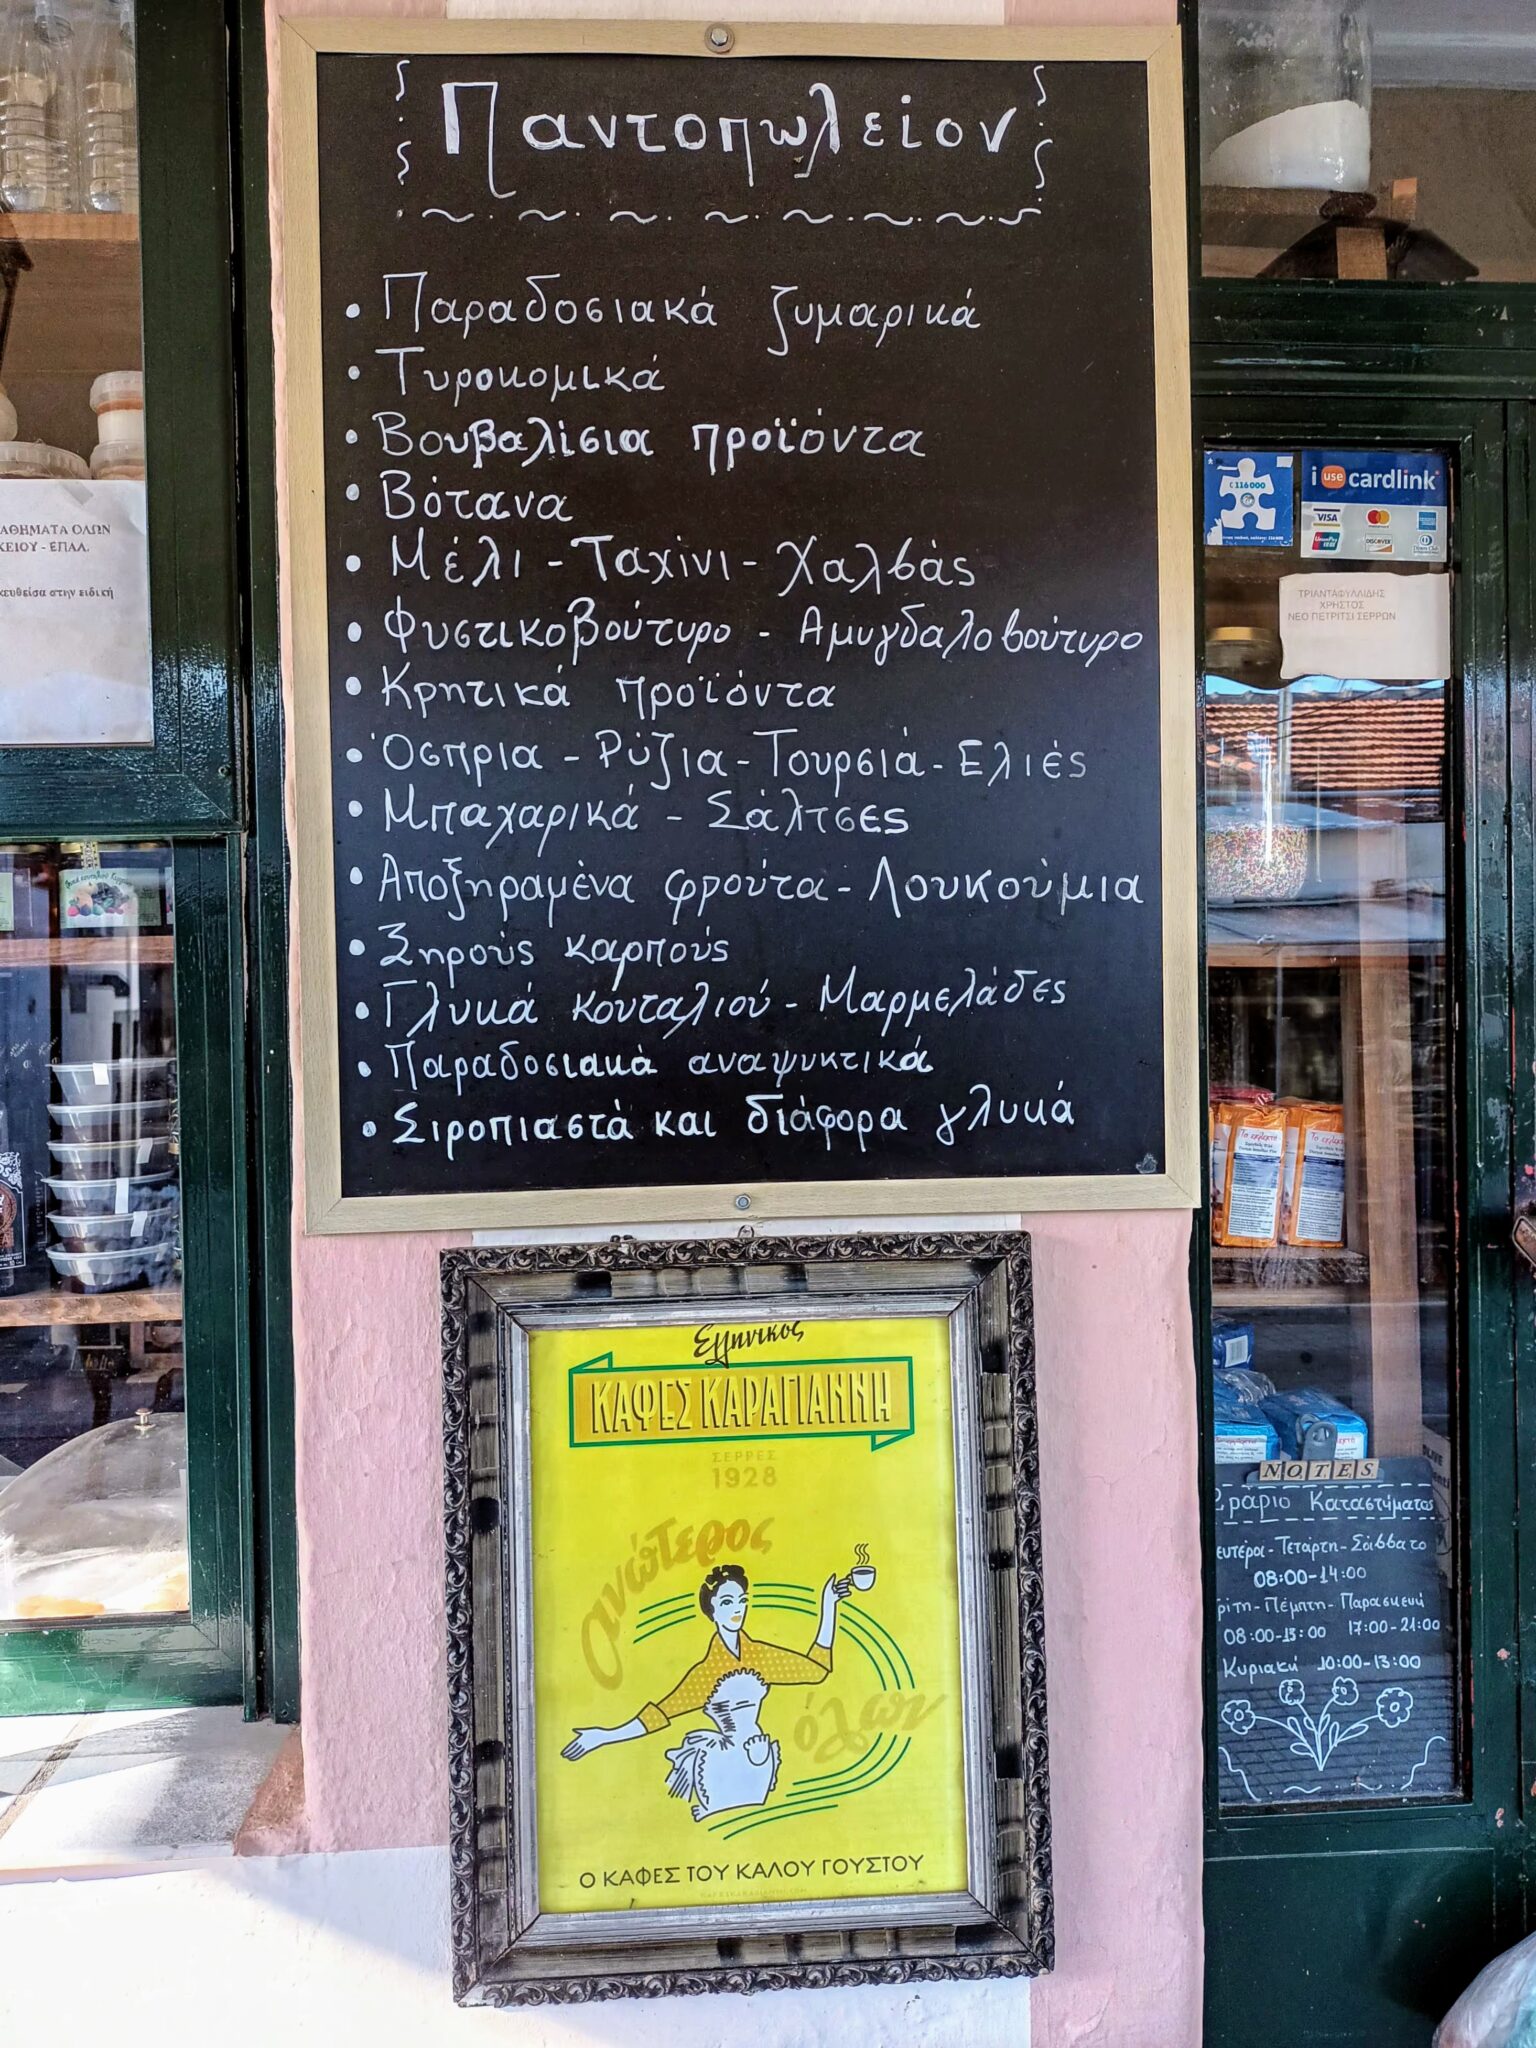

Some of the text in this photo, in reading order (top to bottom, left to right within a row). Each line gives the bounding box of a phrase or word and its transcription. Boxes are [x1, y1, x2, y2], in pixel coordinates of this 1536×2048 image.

[441, 82, 1017, 199] Παντοπωλείον
[383, 271, 981, 356] Παραδοσιακά ζυμαρικά
[375, 347, 665, 407] Τυροκομικά
[372, 408, 925, 476] Βουβαλίσια προϊόντα
[380, 470, 573, 522] Βότανα
[1311, 465, 1437, 490] i use cardlink
[72, 524, 111, 535] ΟΛΩΝ
[1317, 513, 1338, 522] VISA
[49, 541, 90, 552] ΕΠΑΛ.
[392, 527, 975, 597] Μέλι Ταχίνι Χαλβάς
[49, 588, 76, 600] στην
[79, 586, 114, 600] ειδική
[1299, 588, 1385, 598] ΤΡΙΑΝΤΑΦΥΛΛΙΔΗΣ
[1320, 601, 1364, 609] ΧΡΗΣΤΟΣ
[384, 595, 731, 665] Φυστικοβούτυρο
[1288, 611, 1396, 620] ΝΕΟ ΠΕΤΡΙΤΣΙ ΣΕΡΡΩΝ
[382, 662, 835, 720] Κρητικά προϊόντα
[371, 726, 1086, 798] Όσπρια Ρύζια Τουρσιά Ελιές
[385, 783, 908, 857] Μπαχαρικά Σάλτσες
[379, 853, 1144, 928] Αποξηραμένα φρούτα Λουκούμια
[378, 922, 729, 991] Ξηρούς καρπούς
[383, 966, 1066, 1039] Γλυκά κουταλιού Μαρμελάδες
[385, 1035, 934, 1096] Παραδοσιακά αναψυκτικά
[392, 1080, 1074, 1161] Σιροπιαστά και διάφορα γλυκά
[591, 1369, 891, 1434] ΚΑΦΕΣ ΚΑΡΑΓΙΑΝΝΗ
[711, 1450, 777, 1463] ΣΕΡΡΕΣ
[711, 1466, 778, 1489] 1928
[1261, 1461, 1375, 1479] NOTES
[1310, 1490, 1434, 1519] Καταστήματος
[1216, 1533, 1428, 1569] ευτέρα Τετάρτη Σάββατο
[1216, 1592, 1425, 1622] ρίτη Πέμπτη Παρασκευή
[1222, 1655, 1299, 1684] Κυριακή
[579, 1854, 925, 1889] Ο ΚΑΦΕΣ ΤΟΥ ΚΑΛΟΥ ΓΟΥΣΤΟΥ
